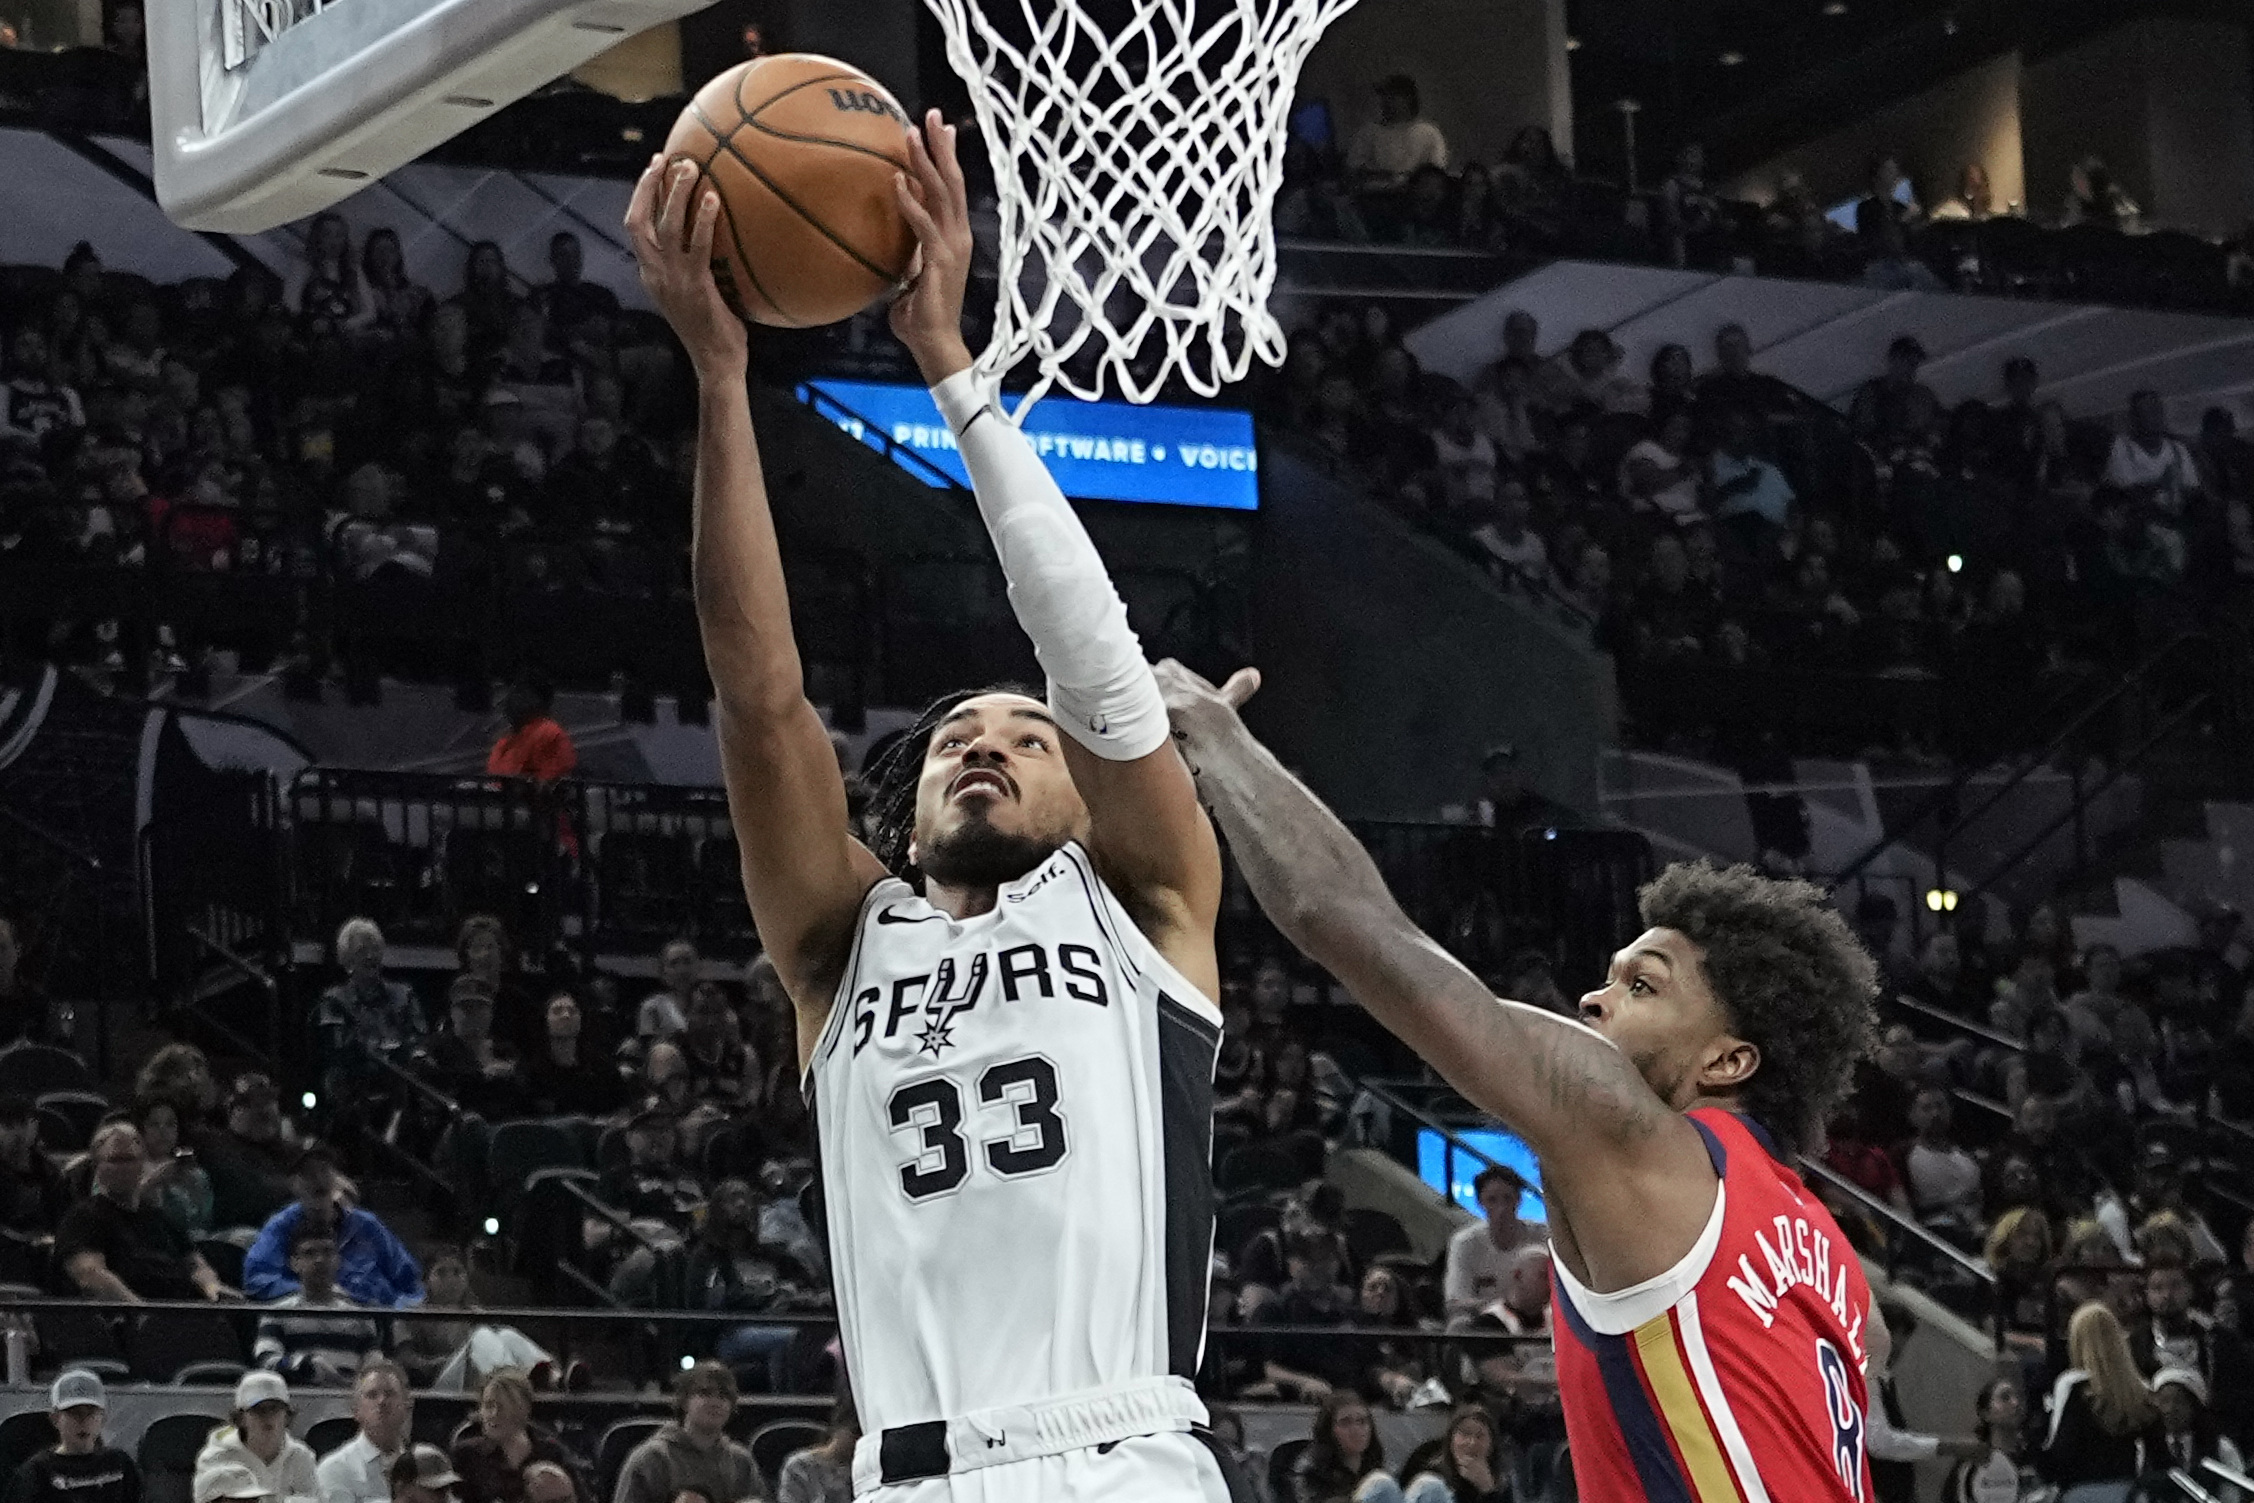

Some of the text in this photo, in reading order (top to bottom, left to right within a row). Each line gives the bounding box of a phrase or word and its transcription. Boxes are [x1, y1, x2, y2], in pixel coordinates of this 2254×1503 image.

[893, 423, 957, 450] PRIN
[852, 942, 1109, 1059] SPURS
[884, 1052, 1072, 1206] 33
